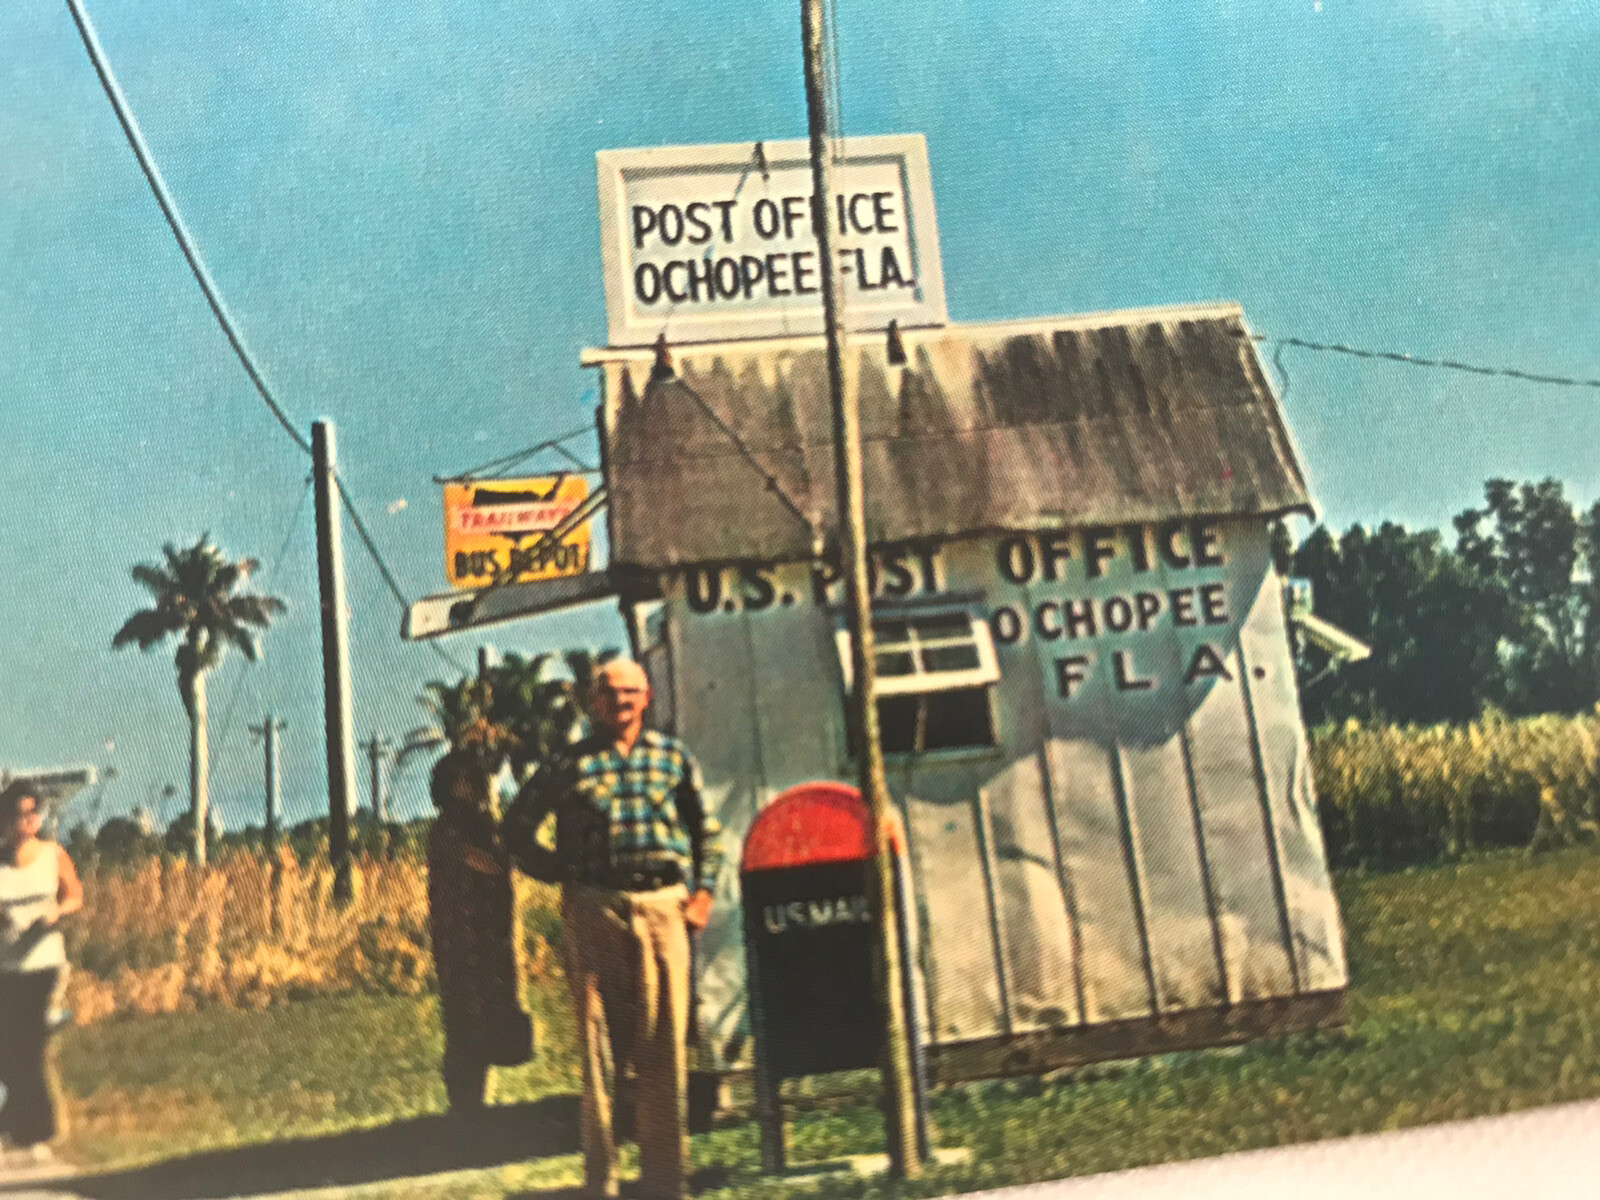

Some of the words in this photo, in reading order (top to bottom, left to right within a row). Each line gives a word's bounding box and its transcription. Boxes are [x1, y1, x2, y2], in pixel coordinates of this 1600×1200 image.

[632, 200, 738, 249] POST
[752, 191, 899, 240] OFICE
[634, 251, 818, 305] OCHOPEE
[455, 551, 499, 579] BUS
[686, 562, 795, 614] U.S.
[996, 523, 1226, 586] OFFICE
[990, 583, 1230, 645] OCHOPEE
